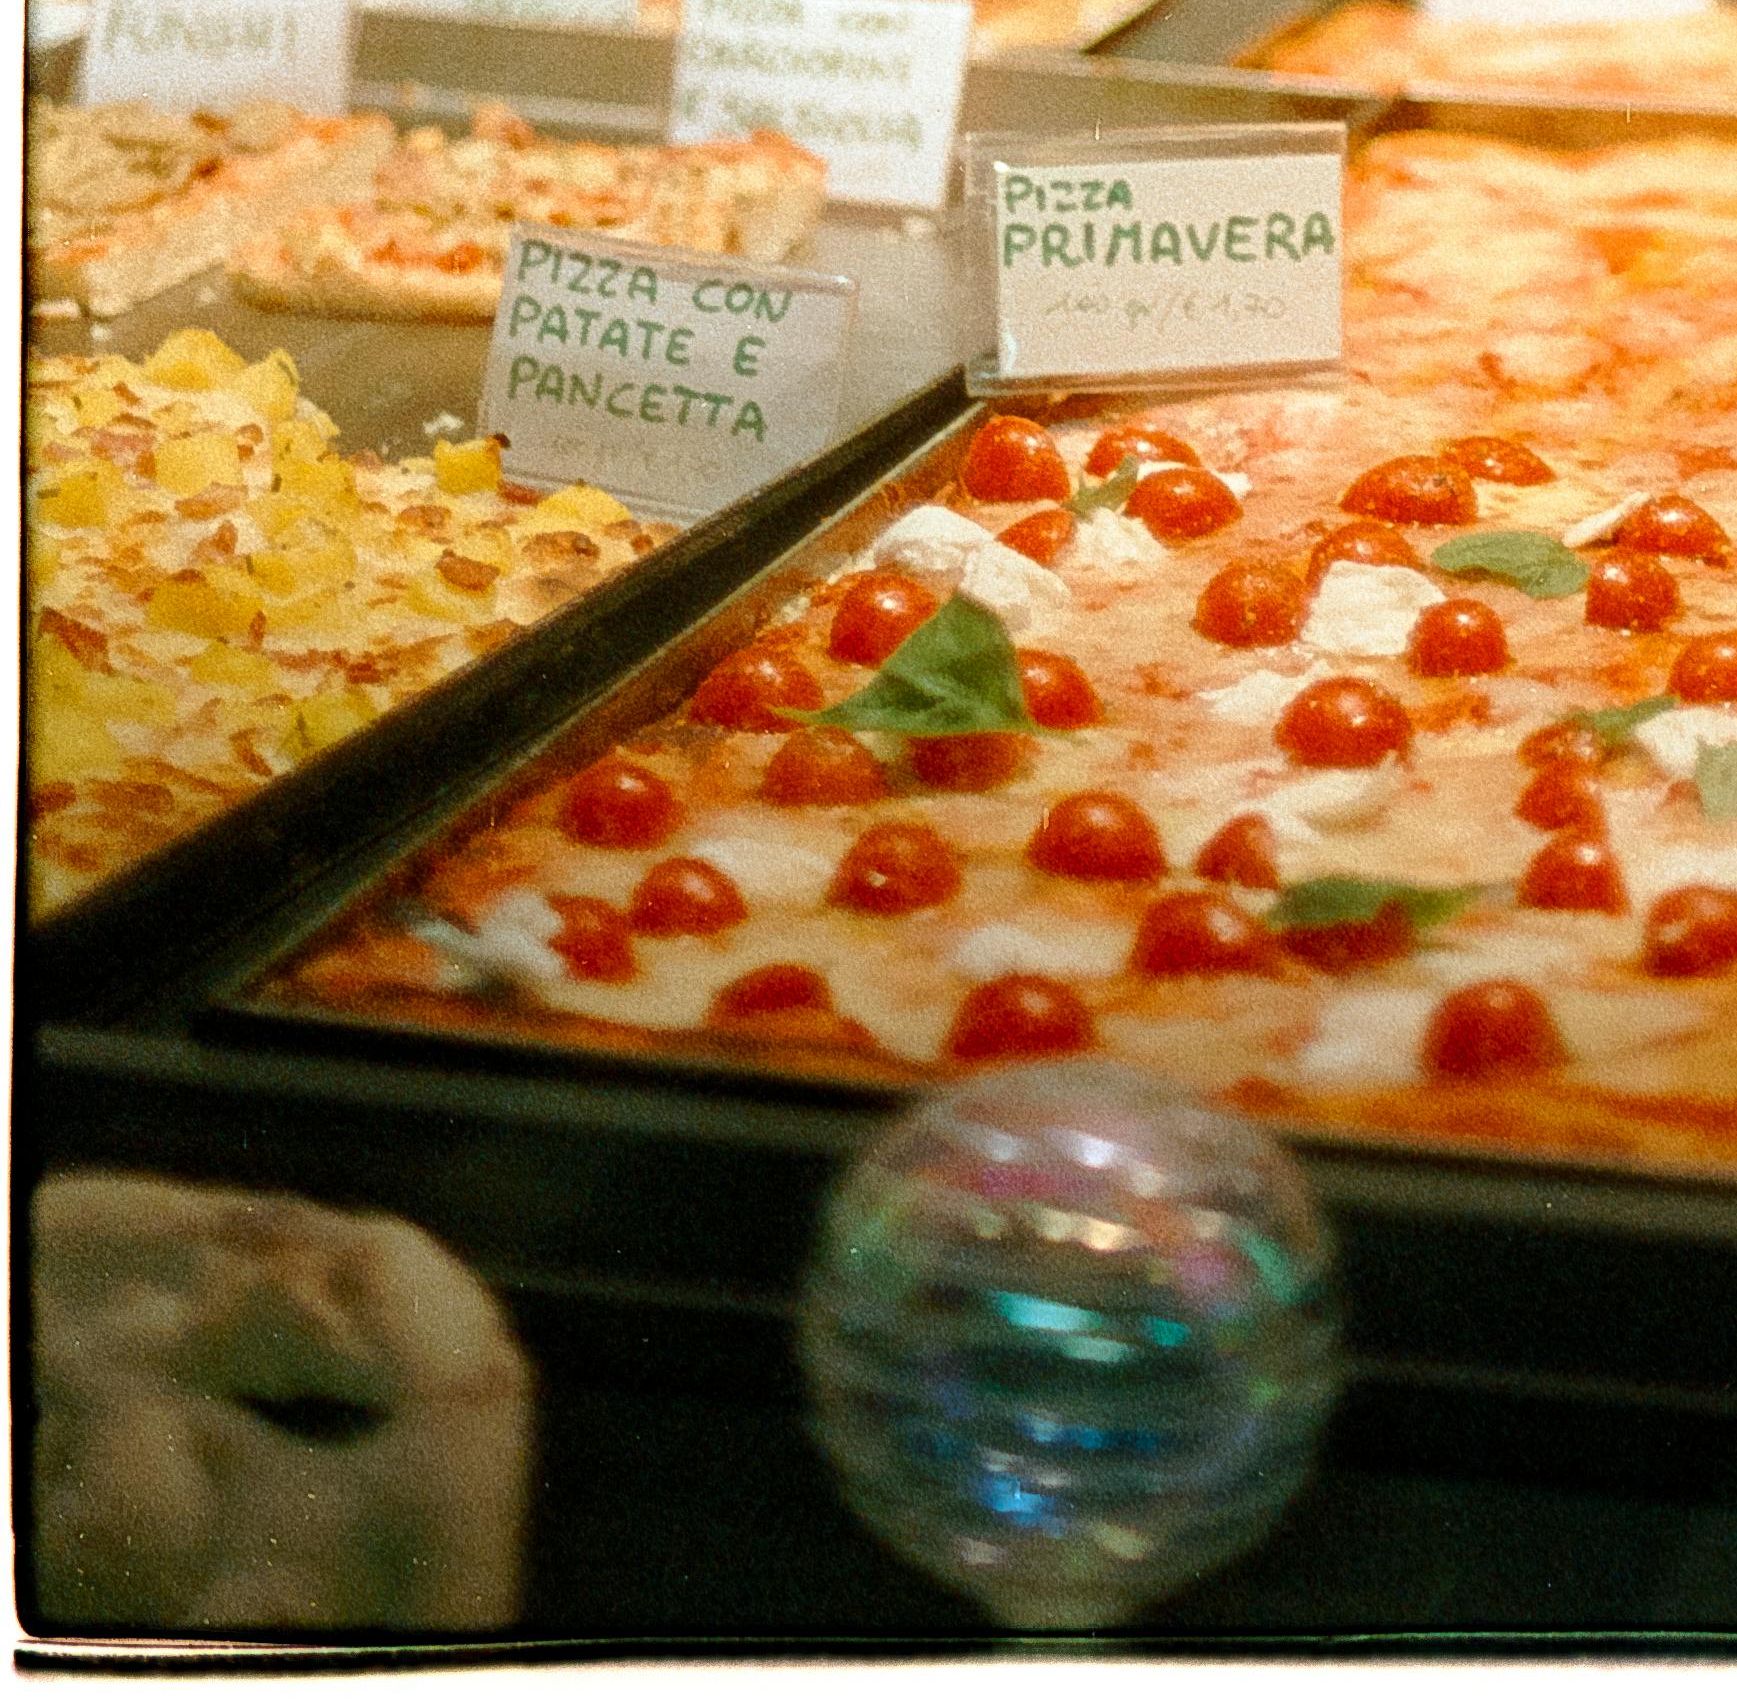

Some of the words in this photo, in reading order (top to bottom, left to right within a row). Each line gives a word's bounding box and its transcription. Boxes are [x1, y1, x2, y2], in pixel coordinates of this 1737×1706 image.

[1005, 175, 1134, 214] PIZZA
[517, 239, 658, 306] PIZZA
[691, 278, 793, 323] CON
[1003, 211, 1336, 269] PRIMAVERA
[508, 294, 696, 366] PATATE
[733, 334, 767, 377] E
[507, 354, 768, 443] PANCETTA
